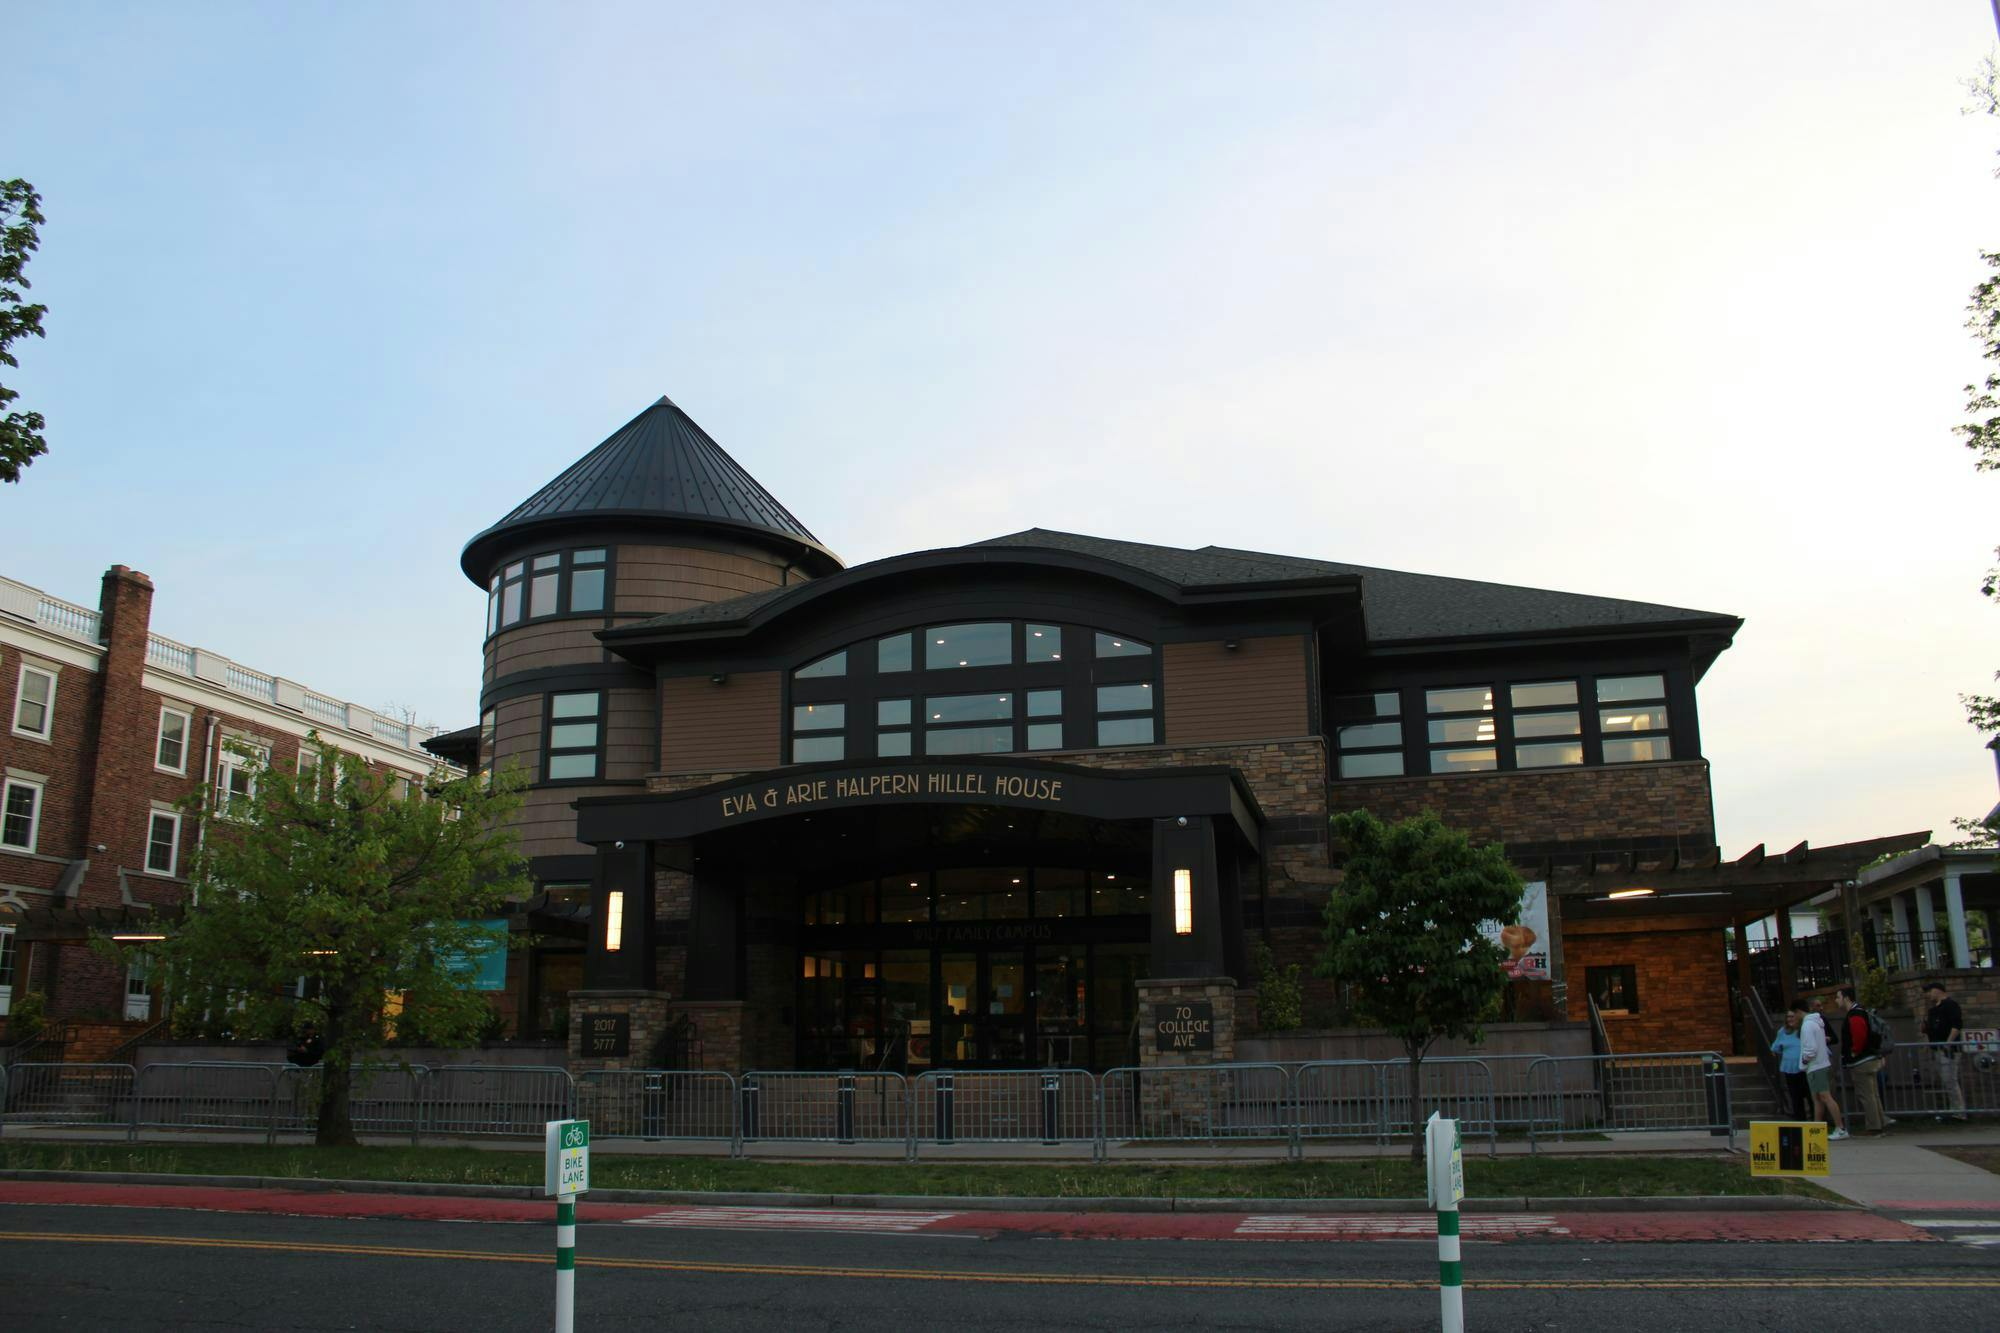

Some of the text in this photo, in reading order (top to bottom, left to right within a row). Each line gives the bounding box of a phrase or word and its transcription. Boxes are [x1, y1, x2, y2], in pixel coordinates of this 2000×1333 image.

[722, 773, 1062, 816] EVA & ARIE HALPERN HILLEL HOUSE
[947, 927, 992, 941] FAMILY
[996, 924, 1052, 940] CAMPUS
[1176, 1007, 1192, 1019] 70
[594, 1019, 616, 1031] 2017
[1159, 1020, 1210, 1033] COLLEGE
[593, 1038, 616, 1050] 5777
[1173, 1035, 1196, 1047] AVE
[1752, 1152, 1776, 1161] WALK
[1807, 1153, 1826, 1162] RIDE
[565, 1157, 583, 1170] BIKE
[563, 1170, 584, 1184] LANE
